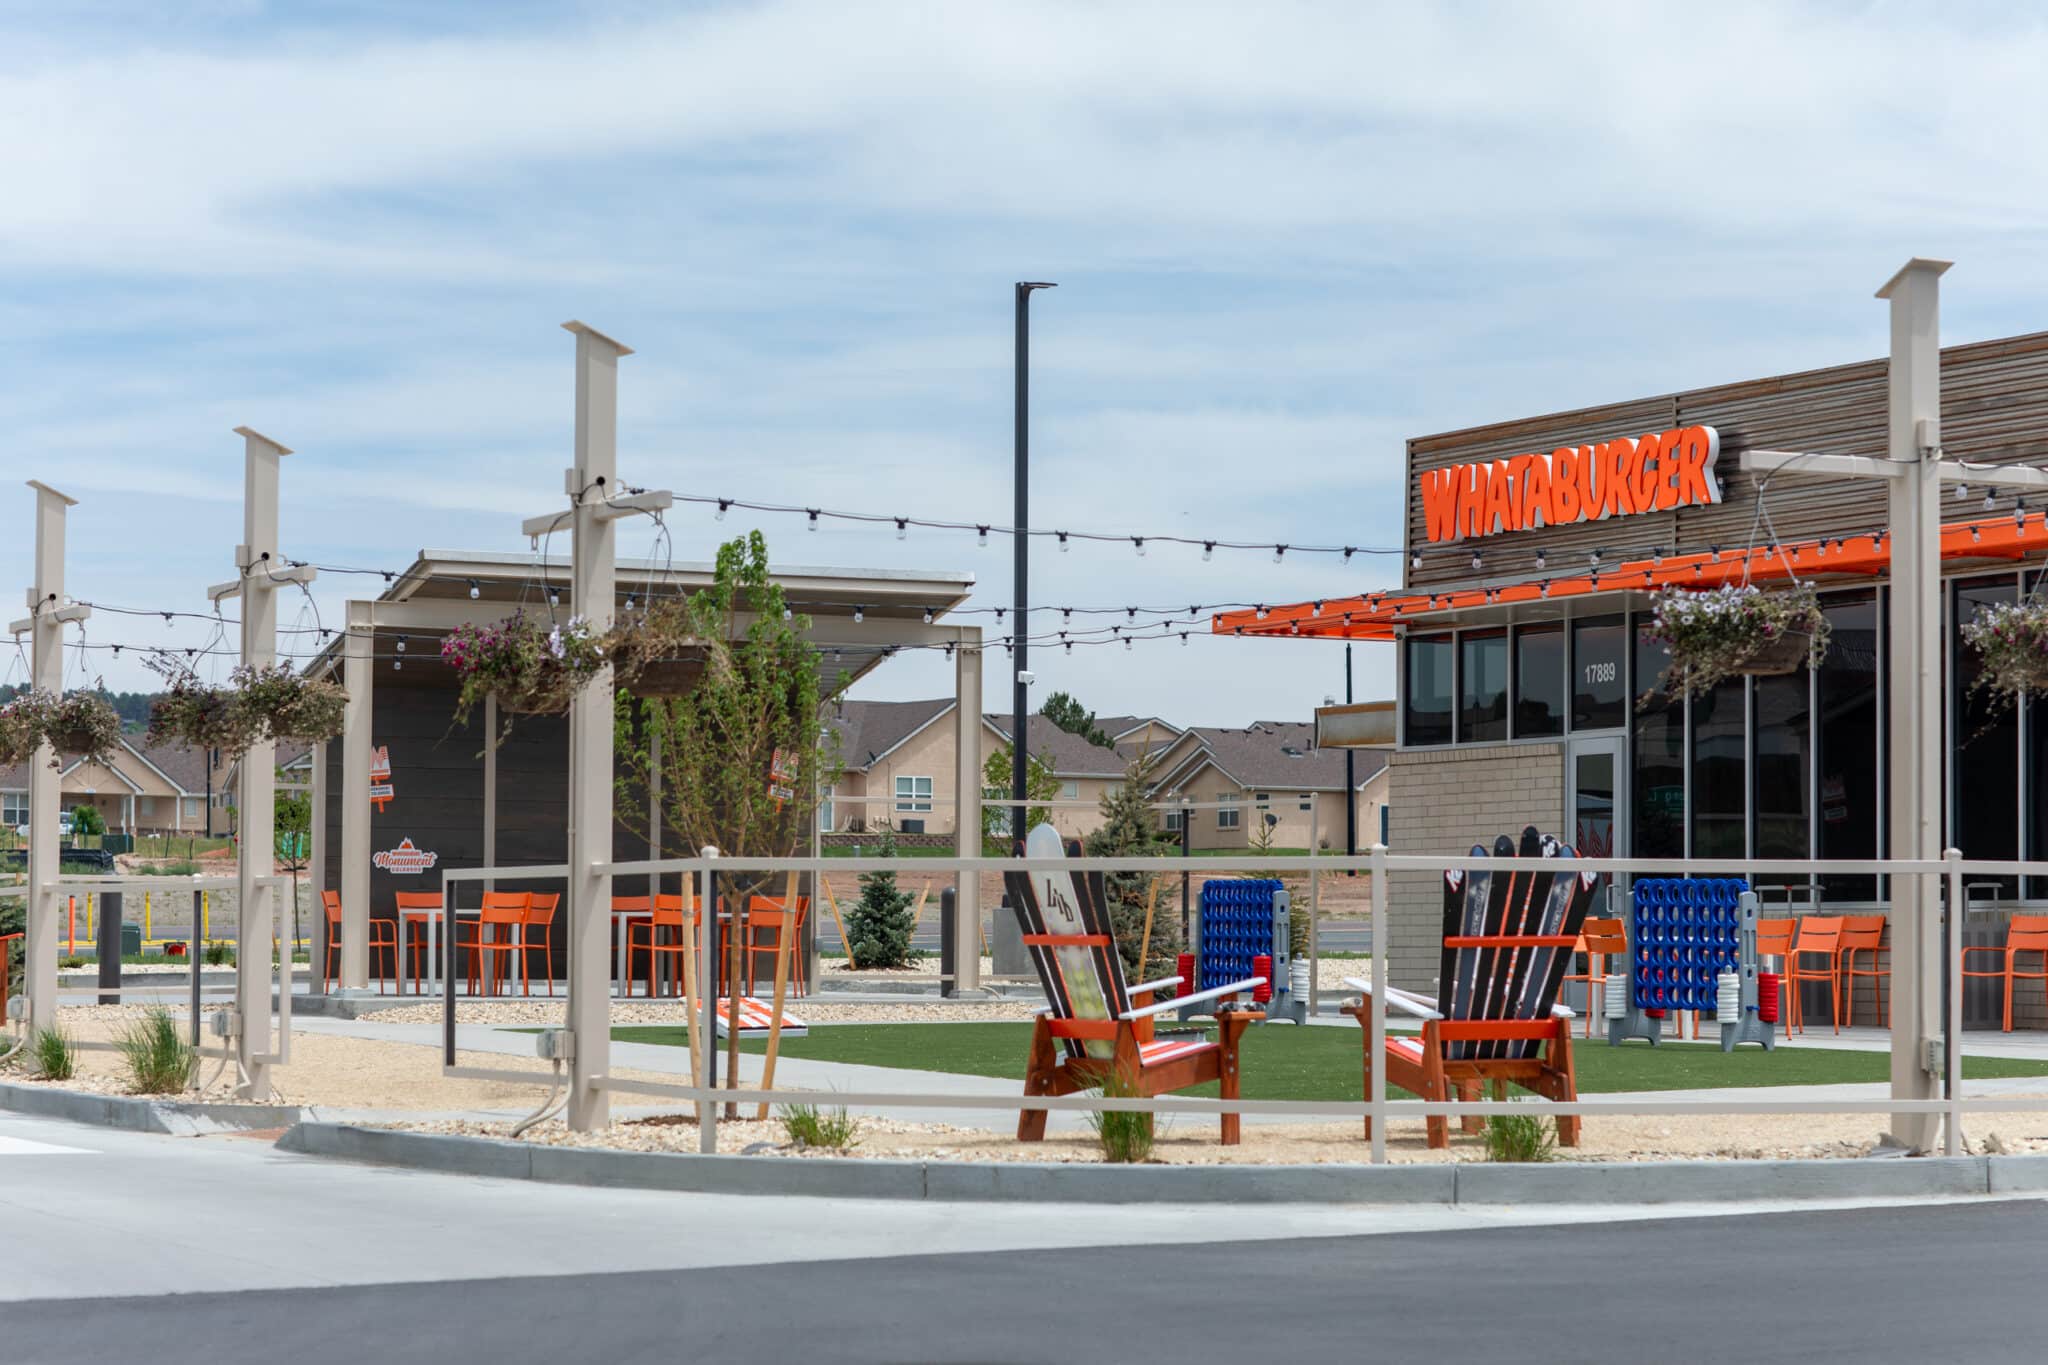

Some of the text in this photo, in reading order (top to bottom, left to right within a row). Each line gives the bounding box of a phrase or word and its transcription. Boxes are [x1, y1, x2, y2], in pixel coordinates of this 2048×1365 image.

[1421, 425, 1717, 542] WHATABURGER
[1585, 662, 1615, 684] 17889
[375, 853, 434, 866] Monument
